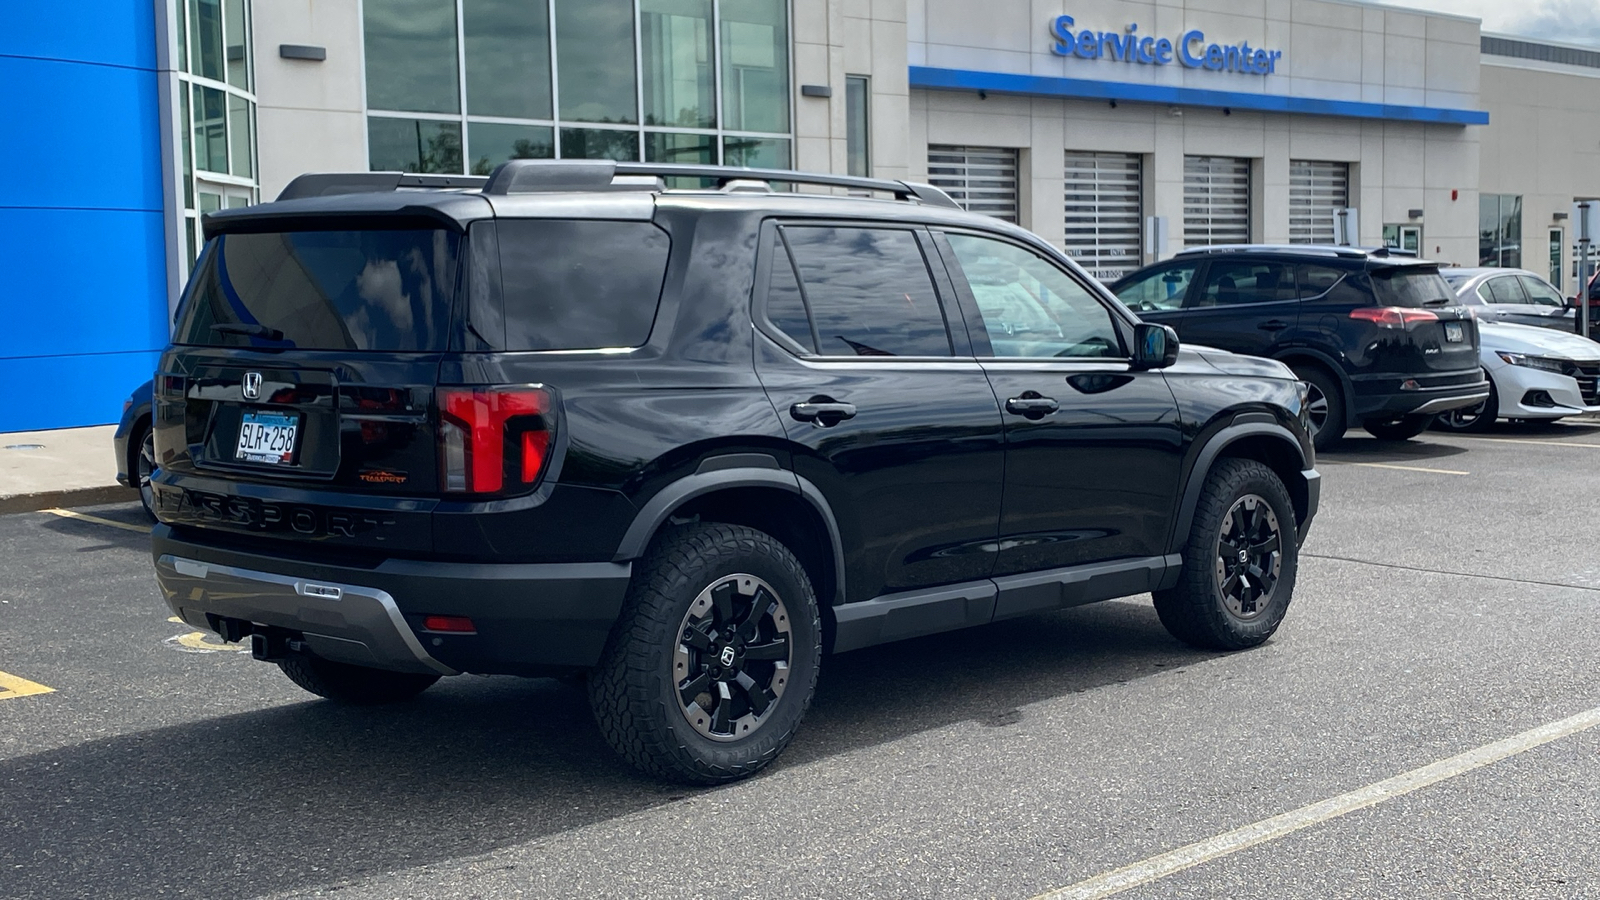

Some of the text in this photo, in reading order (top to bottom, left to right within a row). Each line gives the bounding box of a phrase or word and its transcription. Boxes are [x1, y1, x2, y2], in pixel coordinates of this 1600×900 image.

[1050, 15, 1281, 75] Service Center
[240, 424, 294, 451] SLR 258
[360, 475, 406, 483] TRAILSPORT
[158, 489, 396, 540] PASSPORT
